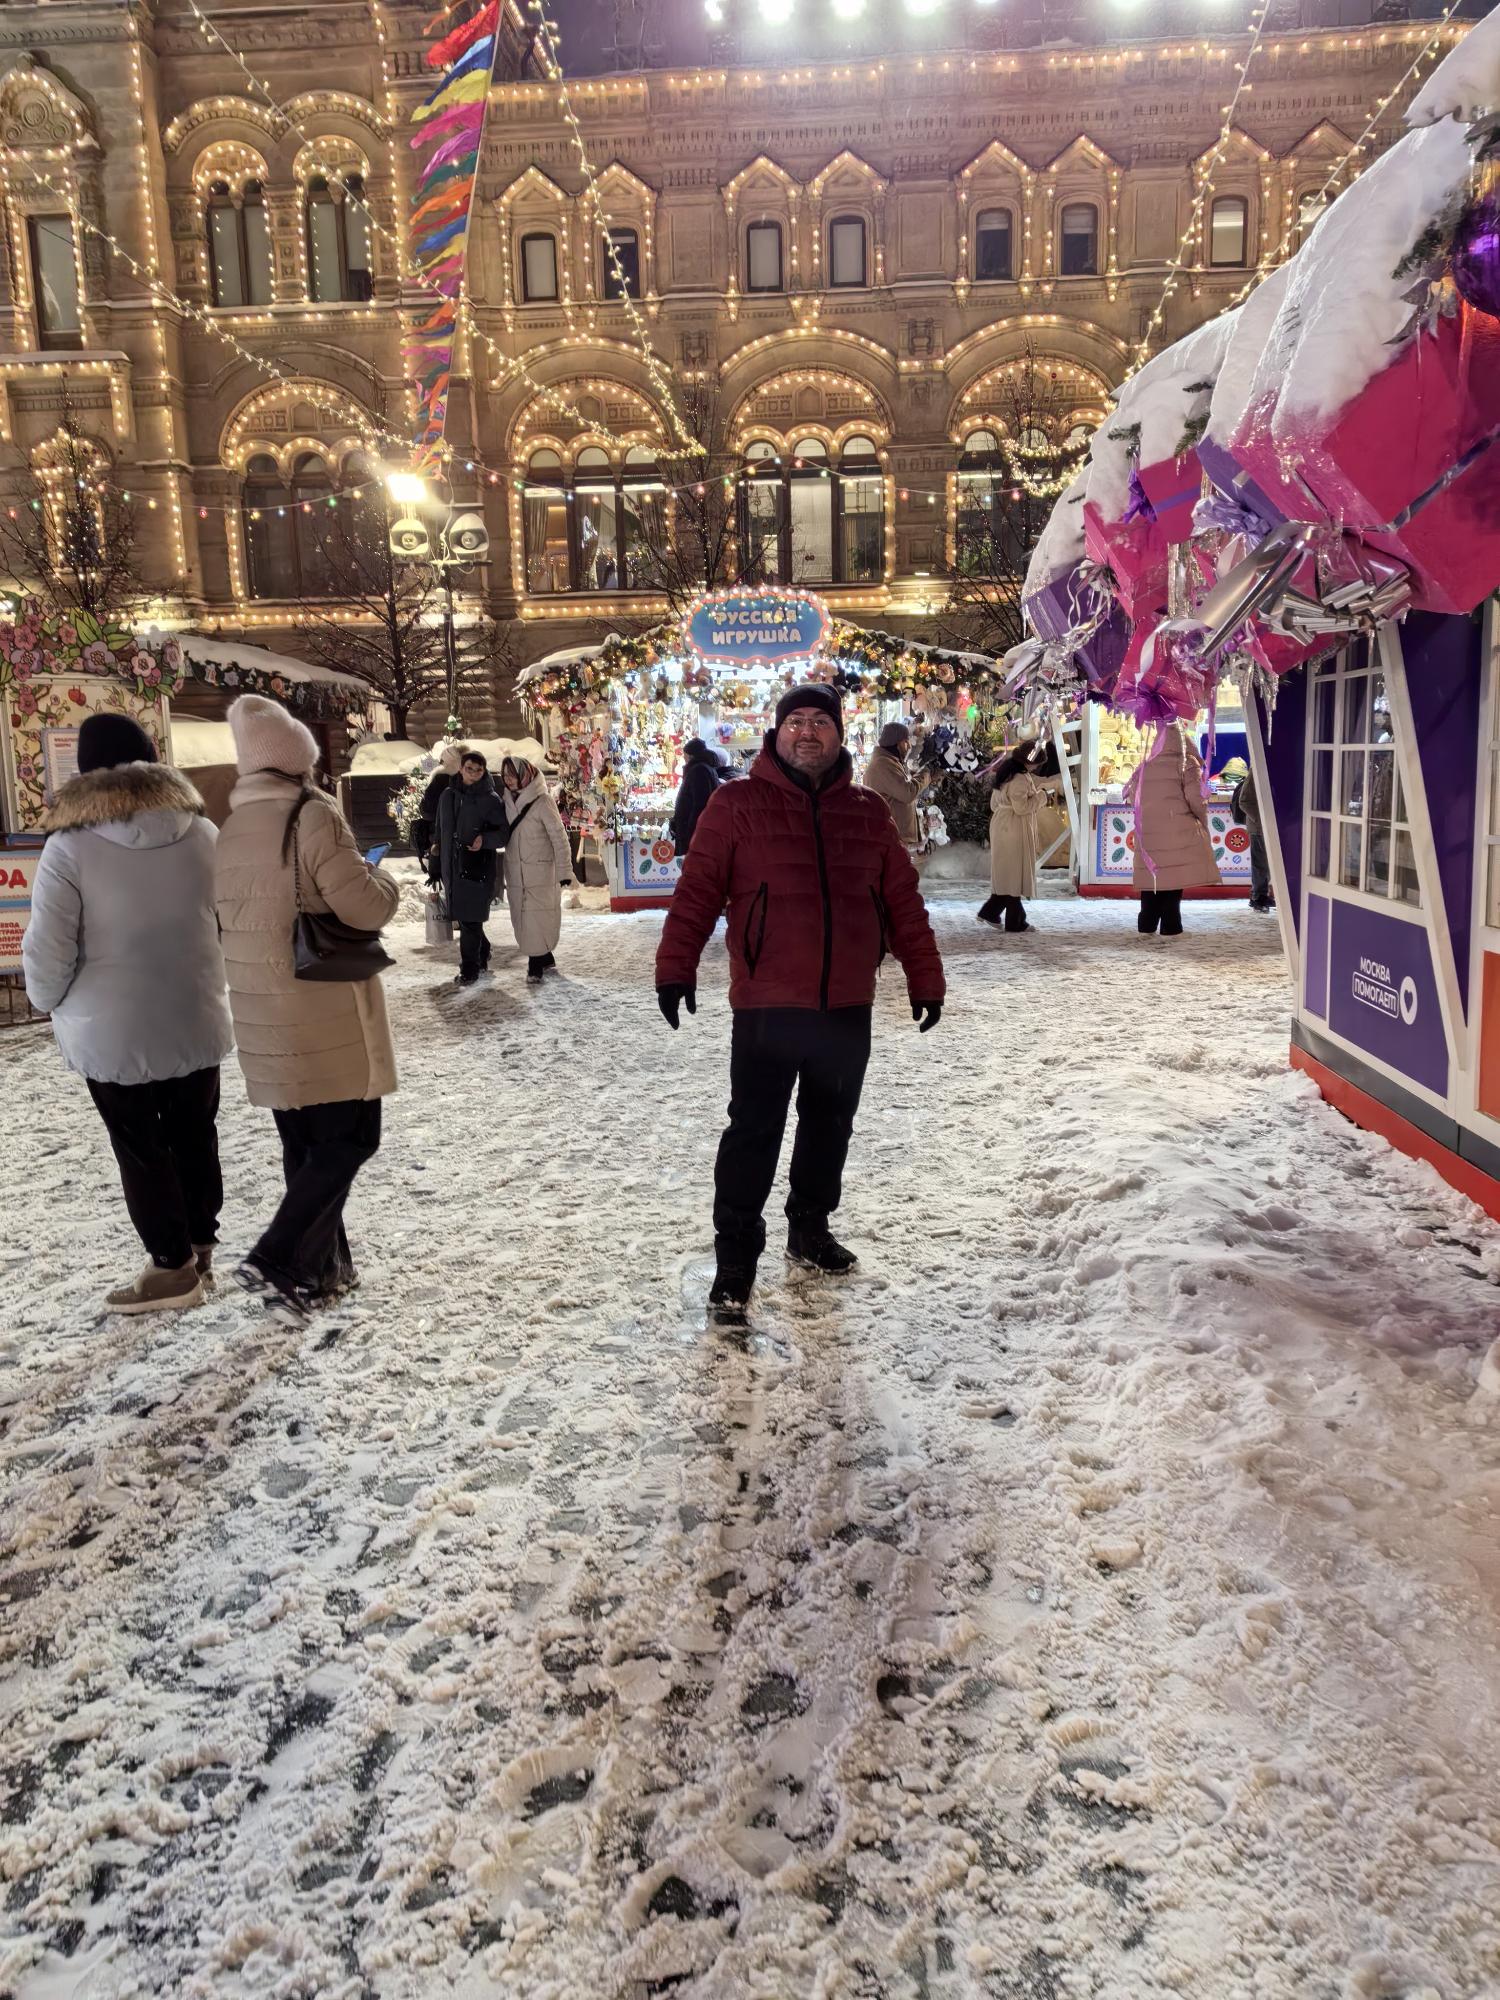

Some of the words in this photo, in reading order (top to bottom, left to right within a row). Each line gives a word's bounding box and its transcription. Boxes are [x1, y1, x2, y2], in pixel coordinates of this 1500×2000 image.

[714, 609, 797, 626] РУССКАЯ
[712, 628, 802, 645] ИГРУШКА
[1360, 956, 1391, 984] МОСКВА
